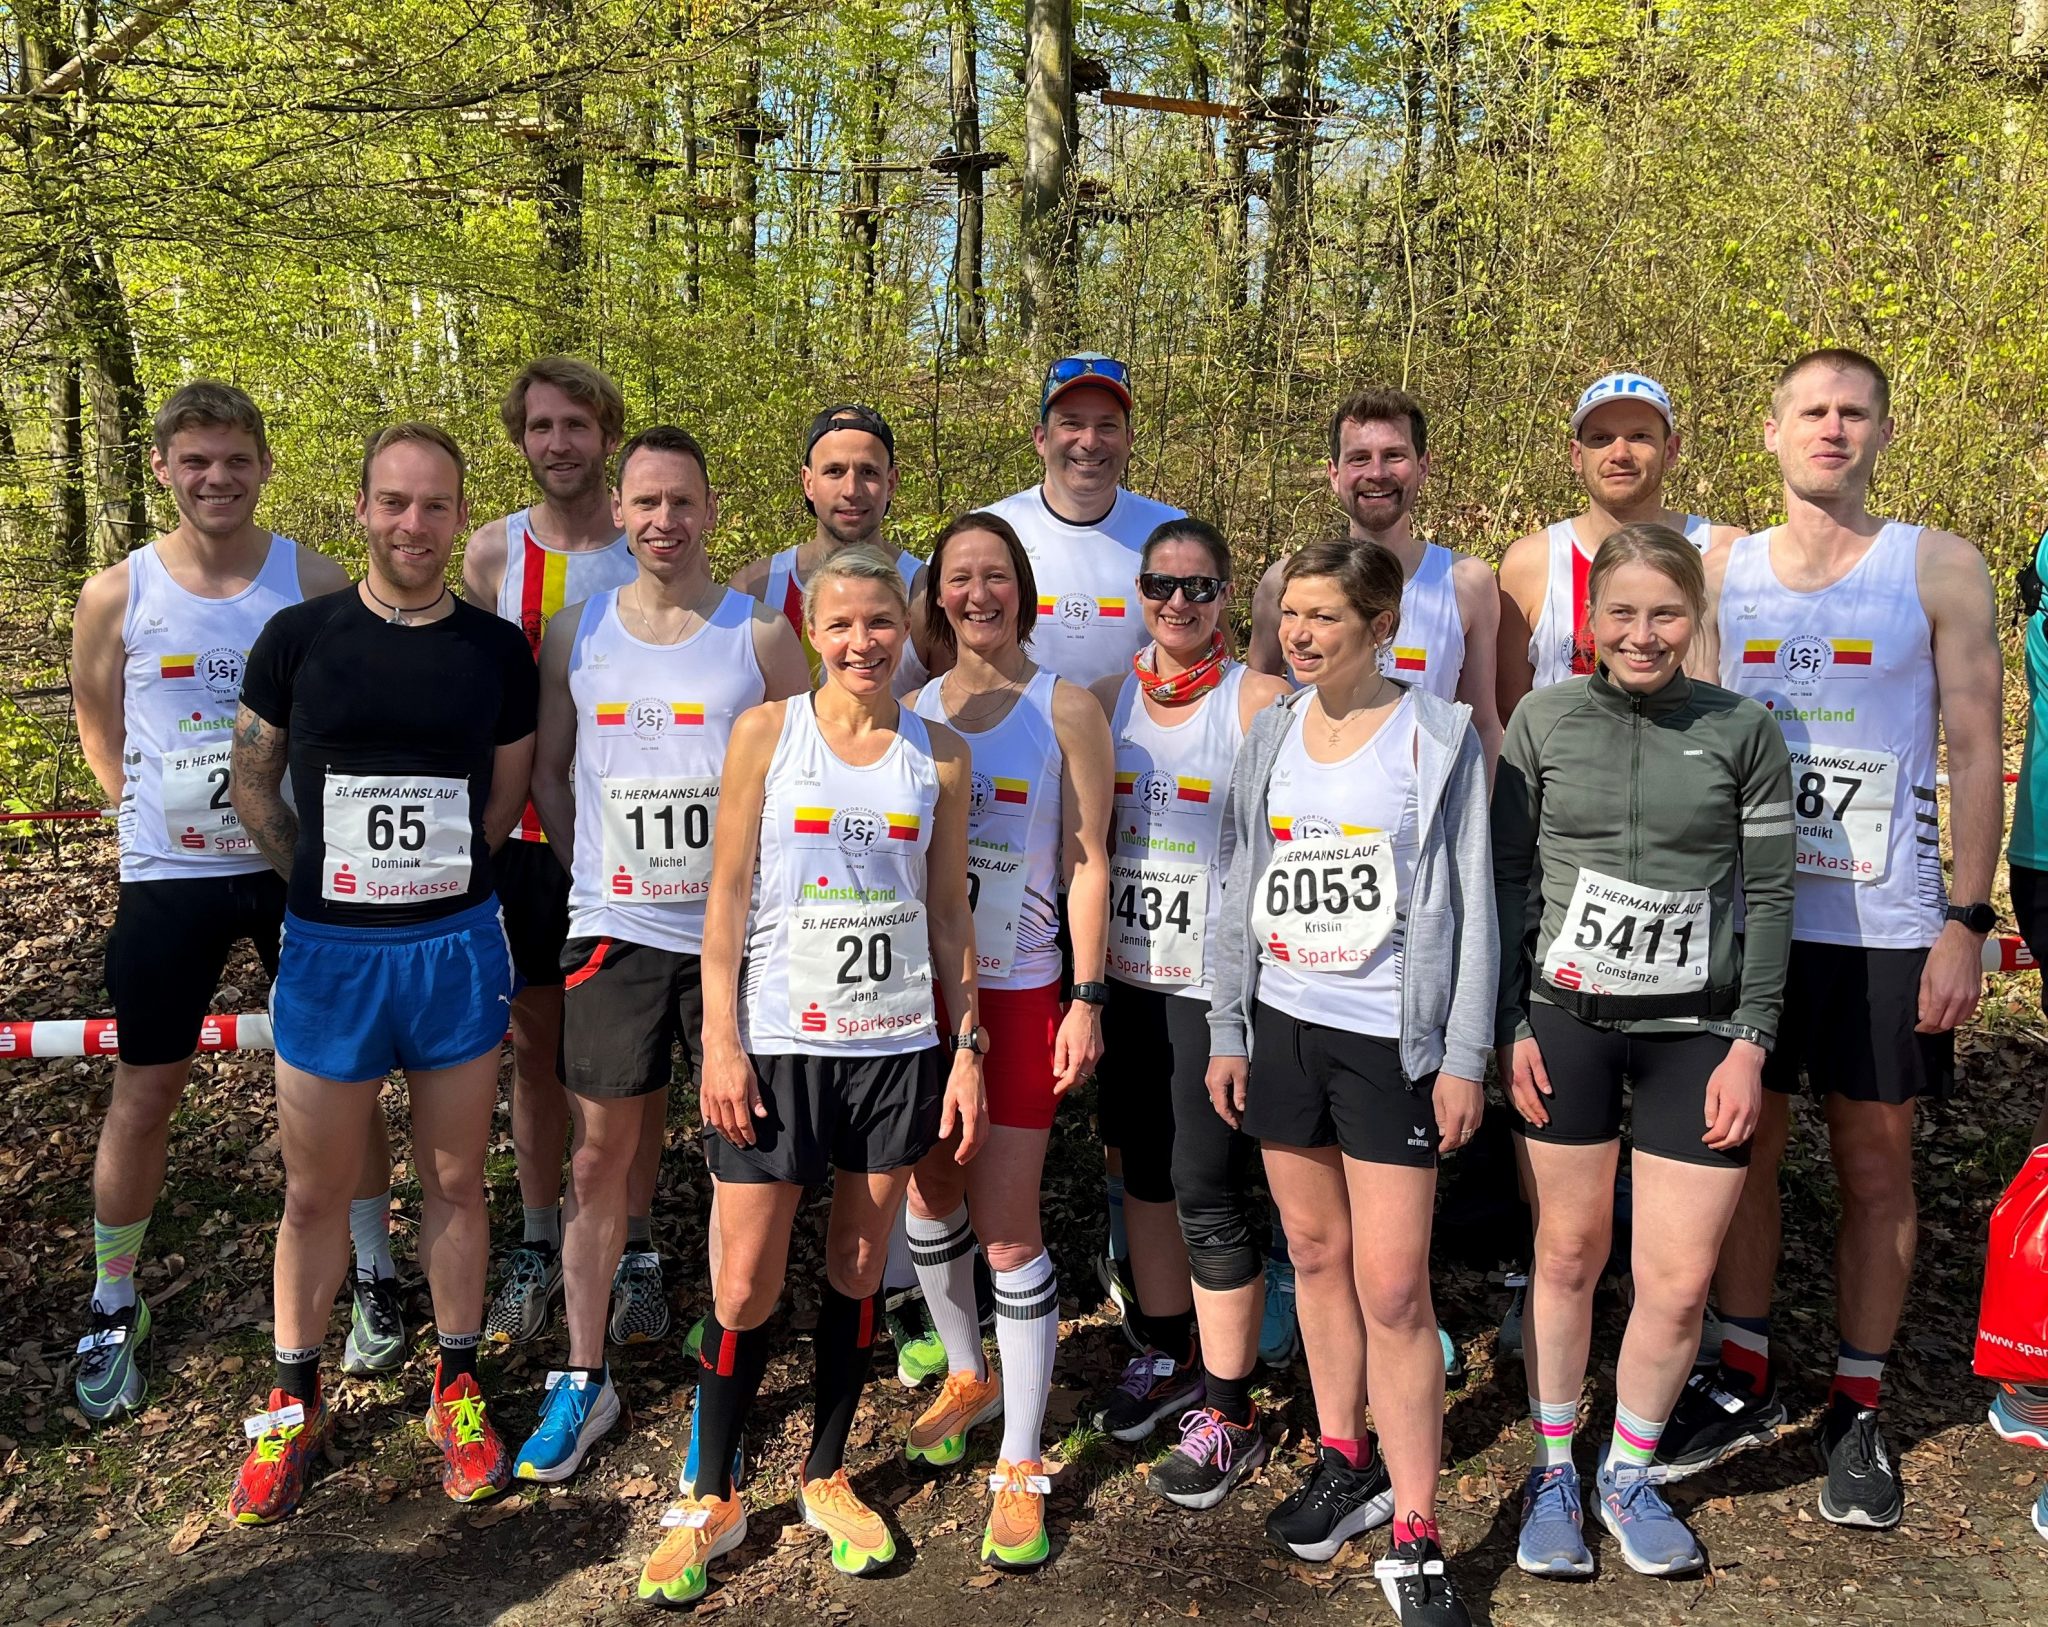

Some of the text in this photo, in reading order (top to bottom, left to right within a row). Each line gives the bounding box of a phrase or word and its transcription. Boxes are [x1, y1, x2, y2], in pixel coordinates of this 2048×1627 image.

[1789, 648, 1821, 673] LSF
[208, 659, 238, 683] LSF
[637, 708, 664, 731] LSF
[175, 760, 189, 770] 51.
[208, 768, 232, 810] 2
[335, 787, 459, 799] 51. HERMANNSLAUF
[610, 789, 622, 799] 51.
[1796, 772, 1862, 821] 87
[367, 804, 426, 851] 65
[626, 804, 709, 850] 110
[843, 817, 875, 846] LSF
[1875, 823, 1882, 832] B
[458, 846, 464, 854] A
[372, 857, 421, 869] Dominik
[650, 856, 686, 868] Michel
[1796, 851, 1872, 873] arkasse
[366, 880, 459, 899] Sparkasse
[1267, 864, 1381, 916] 6053
[1586, 884, 1703, 915] 51. HERMANNSLAUF
[802, 911, 919, 930] 51. HERMANNSLAUF
[1005, 922, 1012, 931] A
[1305, 922, 1342, 933] Kristin
[1120, 933, 1157, 948] Jennifer
[1192, 932, 1199, 941] C
[1575, 902, 1693, 968] 5411
[837, 933, 892, 984] 20
[1118, 956, 1192, 977] Sparkasse
[920, 972, 927, 981] A
[1596, 961, 1659, 984] Constanze
[1695, 966, 1702, 975] D
[851, 990, 878, 1003] Jana
[836, 1012, 922, 1036] Sparkasse
